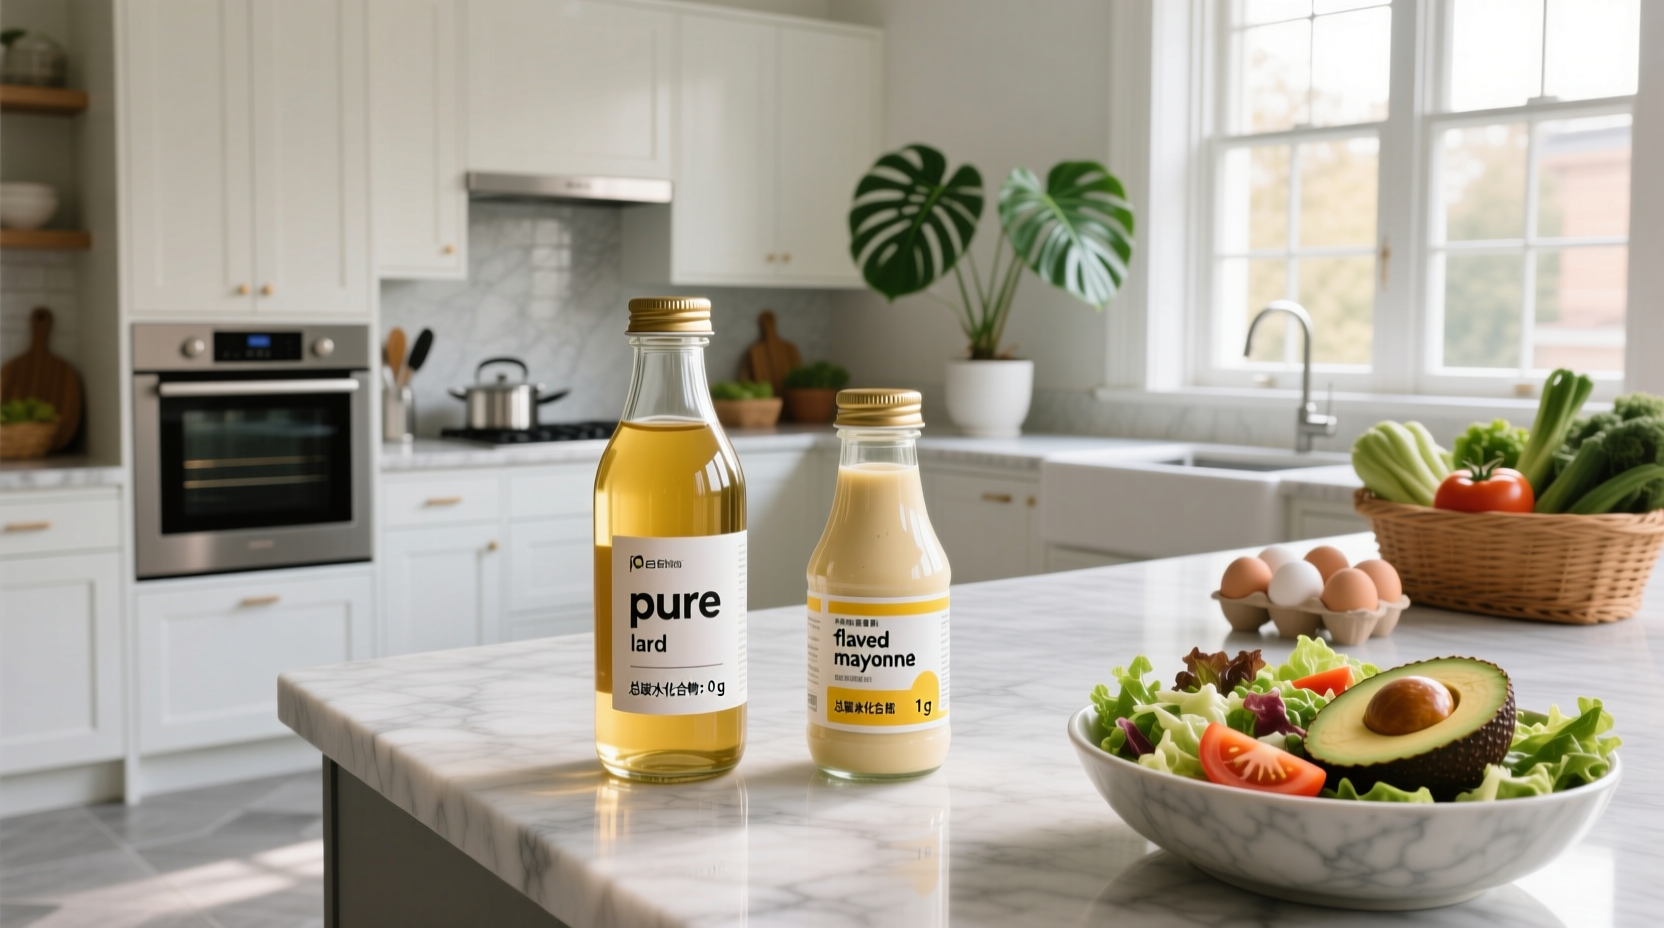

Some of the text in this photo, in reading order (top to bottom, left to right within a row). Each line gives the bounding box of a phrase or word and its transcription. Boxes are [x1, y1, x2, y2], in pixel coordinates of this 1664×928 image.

[630, 591, 721, 628] pure
[631, 633, 667, 652] lard
[833, 628, 889, 648] flaved
[834, 652, 916, 673] mayonne
[915, 698, 932, 716] 1g
